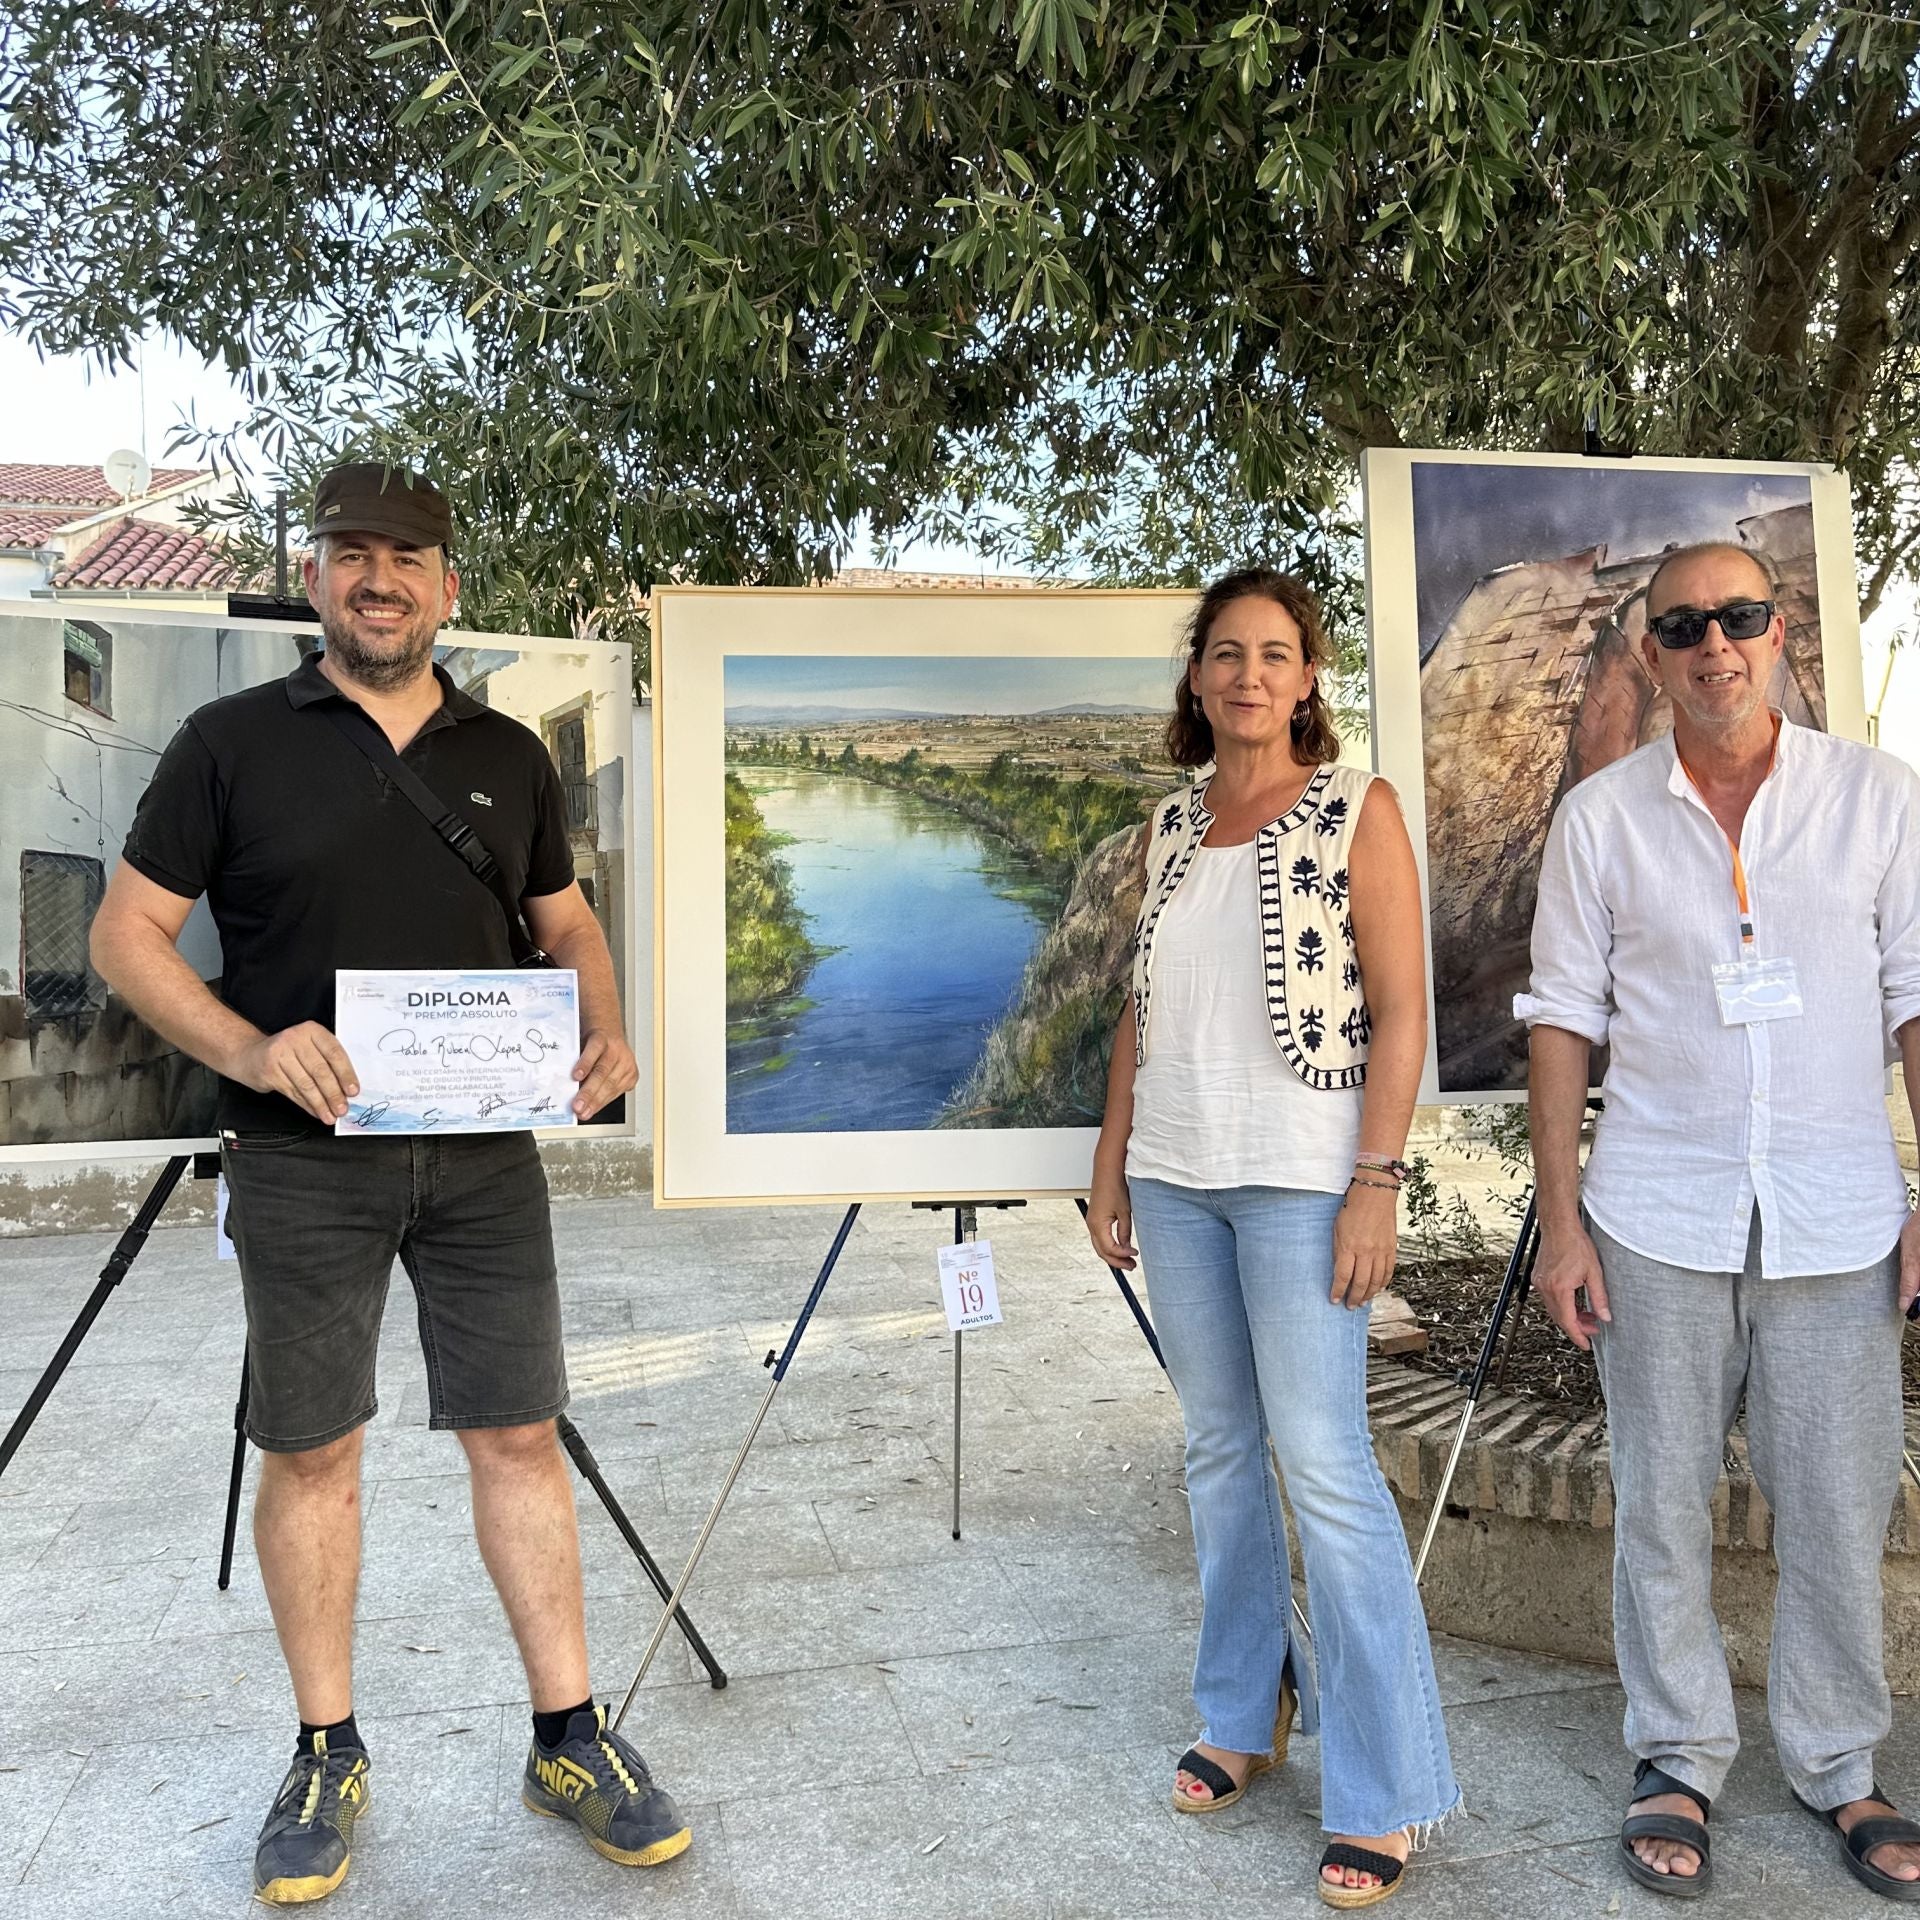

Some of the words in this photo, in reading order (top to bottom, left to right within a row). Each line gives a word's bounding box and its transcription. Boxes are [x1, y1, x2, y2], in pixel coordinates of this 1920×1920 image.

[408, 991, 511, 1007] DIPLOMA
[415, 1011, 458, 1020] PREMIO
[460, 1009, 518, 1019] ABSOLUTO
[958, 1284, 984, 1314] 19
[960, 1314, 994, 1325] ADULTOS
